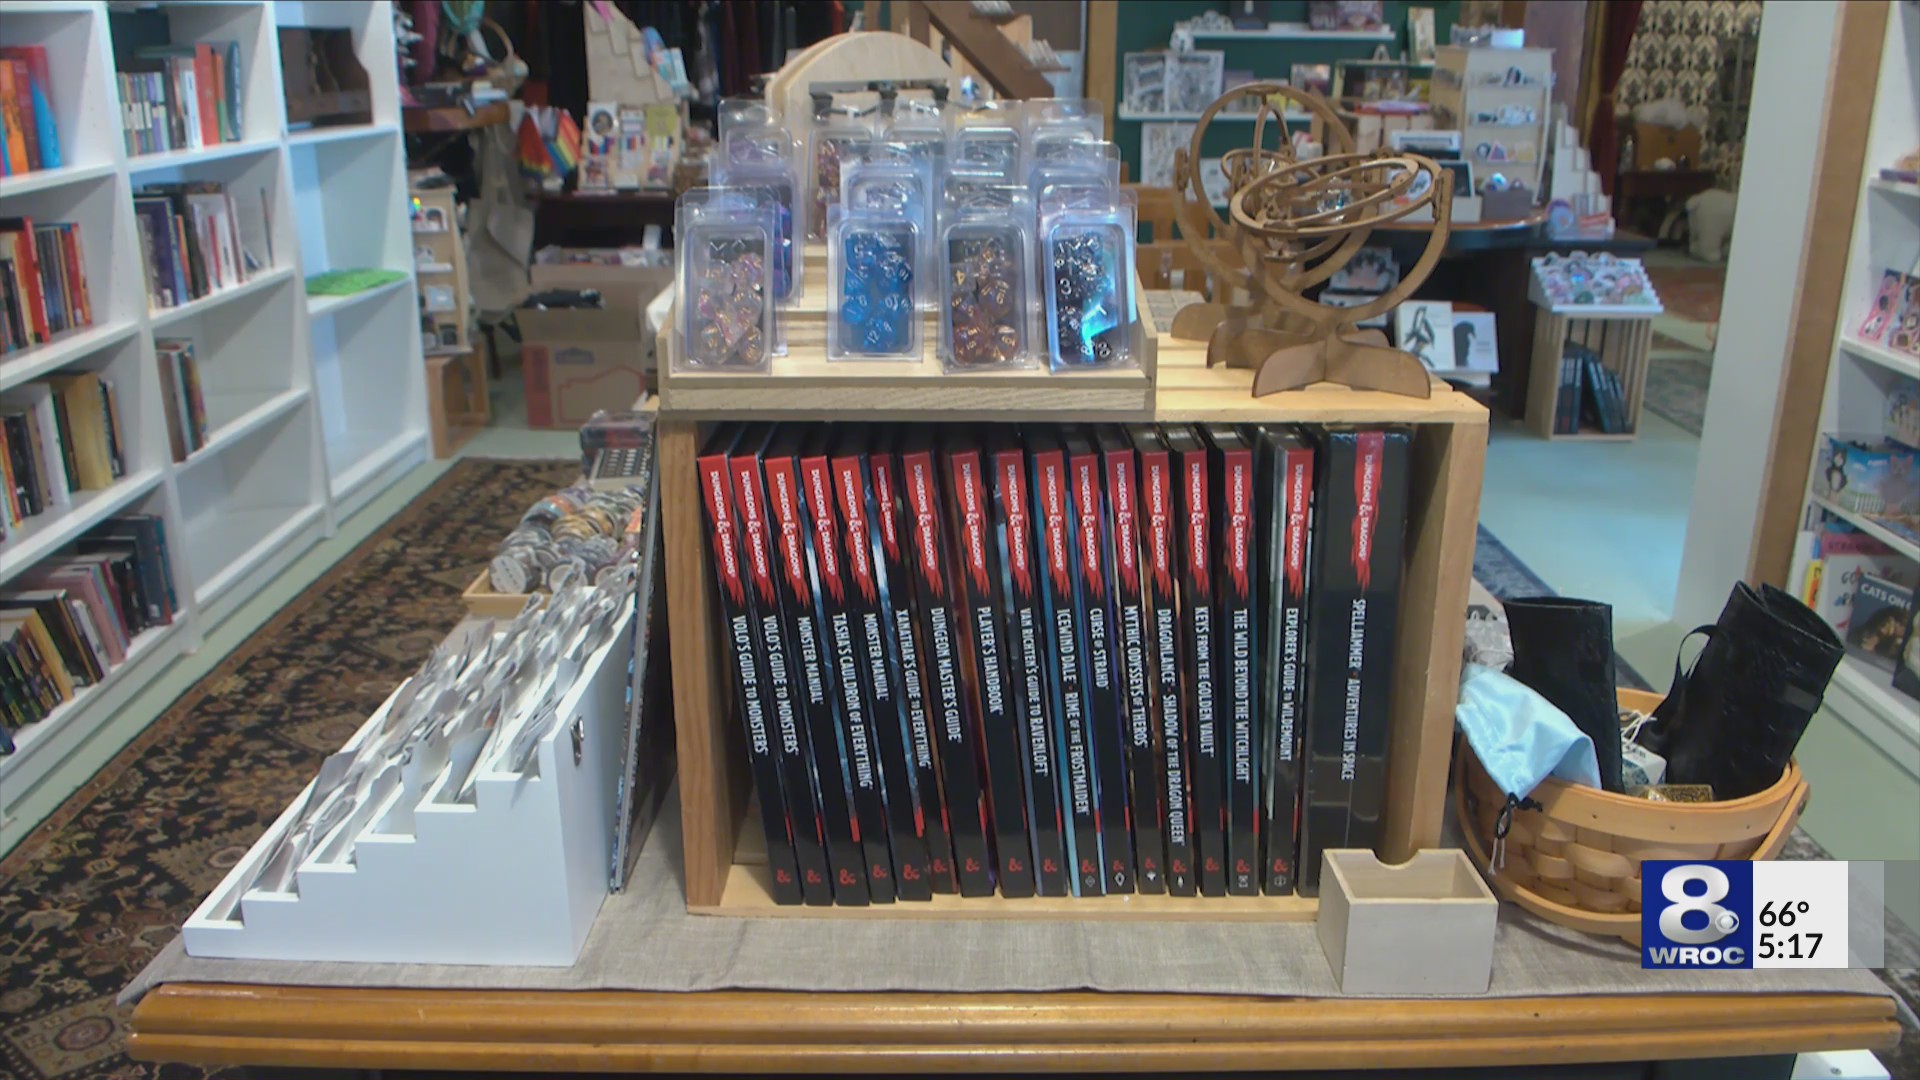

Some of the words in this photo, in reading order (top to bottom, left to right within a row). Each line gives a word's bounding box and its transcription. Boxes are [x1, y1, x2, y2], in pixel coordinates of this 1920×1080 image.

[710, 471, 727, 521] DUNGEONS
[741, 471, 758, 521] DUNGEONS
[776, 472, 792, 523] DUNGEONS
[811, 469, 828, 519] DUNGEONS
[843, 470, 859, 520] DUNGEONS
[877, 466, 889, 503] DUNGEONS
[914, 464, 927, 514] DUNGEONS
[962, 463, 976, 513] DUNGEONS
[1007, 464, 1019, 513] DUNGEONS
[1046, 465, 1058, 513] DUNGEONS
[1080, 465, 1092, 513] DUNGEONS
[1117, 463, 1128, 511] DUNGEONS
[1151, 465, 1162, 513] DUNGEONS
[1192, 463, 1201, 511] DUNGEONS
[1234, 465, 1243, 514] DUNGEONS
[1293, 464, 1303, 513] DUNGEONS
[1362, 454, 1372, 503] DUNGEONS
[717, 521, 731, 533] &
[748, 521, 761, 533] &
[782, 522, 796, 535] &
[817, 519, 831, 531] &
[849, 520, 862, 533] &
[881, 502, 892, 512] &
[918, 514, 932, 527] &
[965, 513, 979, 526] &
[1010, 514, 1023, 526] &
[1049, 514, 1062, 527] &
[1082, 514, 1095, 527] &
[1118, 512, 1131, 524] &
[1152, 514, 1165, 527] &
[1191, 512, 1204, 524] &
[1233, 514, 1246, 527] &
[1290, 513, 1303, 525] &
[1359, 503, 1372, 516] &
[721, 532, 736, 578] DRAGONS
[752, 532, 766, 578] DRAGONS
[787, 533, 801, 579] DRAGONS
[821, 530, 836, 576] DRAGONS
[853, 532, 867, 577] DRAGONS
[923, 525, 936, 570] DRAGONS
[968, 524, 982, 569] DRAGONS
[1013, 526, 1025, 570] DRAGONS
[1052, 527, 1063, 571] DRAGONS
[1085, 527, 1097, 570] DRAGONS
[1121, 524, 1132, 568] DRAGONS
[1155, 527, 1165, 571] DRAGONS
[1194, 525, 1203, 568] DRAGONS
[1235, 527, 1244, 571] DRAGONS
[1291, 526, 1300, 570] DRAGONS
[1359, 517, 1369, 561] DRAGONS
[1861, 583, 1887, 602] CATS
[1888, 594, 1908, 608] ON
[732, 615, 751, 652] VOLO'S
[763, 615, 782, 652] VOLO'S
[797, 616, 817, 662] MONSTER
[832, 612, 852, 655] TASHA'S
[863, 613, 882, 658] MONSTER
[895, 608, 916, 669] XANATHAR'S
[930, 607, 951, 661] DUNGEON
[977, 606, 996, 656] PLAYER'S
[1020, 607, 1033, 629] VAN
[1056, 609, 1075, 654] ICEWIND
[1089, 608, 1104, 639] CURSE
[1124, 605, 1140, 647] MYTHIC
[1194, 606, 1209, 633] KEYS
[1234, 608, 1248, 630] THE
[1284, 607, 1299, 663] EXPLORER'S
[1348, 599, 1366, 670] SPELLJAMMER
[1021, 628, 1038, 675] RICHTEN'S
[1157, 609, 1175, 685] DRAGONLANCE
[1197, 634, 1209, 661] FROM
[1234, 631, 1248, 658] WILD
[739, 653, 757, 686] GUIDE
[769, 653, 787, 686] GUIDE
[805, 663, 823, 704] MANUAL
[839, 656, 861, 711] CAULDRON
[871, 658, 889, 701] MANUAL
[905, 669, 921, 700] GUIDE
[937, 658, 957, 709] MASTER'S
[983, 656, 1003, 714] HANDBOOK
[1026, 674, 1040, 703] GUIDE
[1060, 655, 1077, 684] DALE
[1093, 649, 1109, 689] STRAHD
[1127, 647, 1144, 698] ODYSSEYS
[1198, 662, 1209, 680] THE
[1234, 658, 1248, 699] BEYOND
[1283, 663, 1296, 691] GUIDE
[745, 687, 758, 699] TO
[776, 687, 788, 699] TO
[1029, 703, 1041, 717] TO
[1064, 692, 1081, 719] RIME
[1197, 681, 1212, 721] GOLDEN
[1235, 699, 1249, 720] THE
[1344, 678, 1361, 741] ADVENTURES
[747, 700, 768, 754] MONSTERS
[777, 700, 798, 754] MONSTERS
[849, 710, 861, 724] OF
[944, 709, 962, 742] GUIDE
[1070, 730, 1081, 744] THE
[1132, 707, 1148, 747] THEROS
[1162, 694, 1178, 737] SHADOW
[1280, 701, 1295, 761] WILDEMOUNT
[850, 725, 873, 789] EVERYTHING
[911, 709, 931, 768] EVERYTHING
[1029, 717, 1048, 776] RAVENLOFT
[1166, 751, 1180, 769] THE
[1200, 722, 1214, 756] VAULT
[1235, 720, 1249, 782] WITCHLIGHT
[1343, 741, 1356, 752] IN
[1070, 745, 1090, 815] FROSTMAIDEN
[1341, 752, 1355, 781] SPACE
[1167, 770, 1183, 810] DRAGON
[1168, 810, 1184, 844] QUEEN
